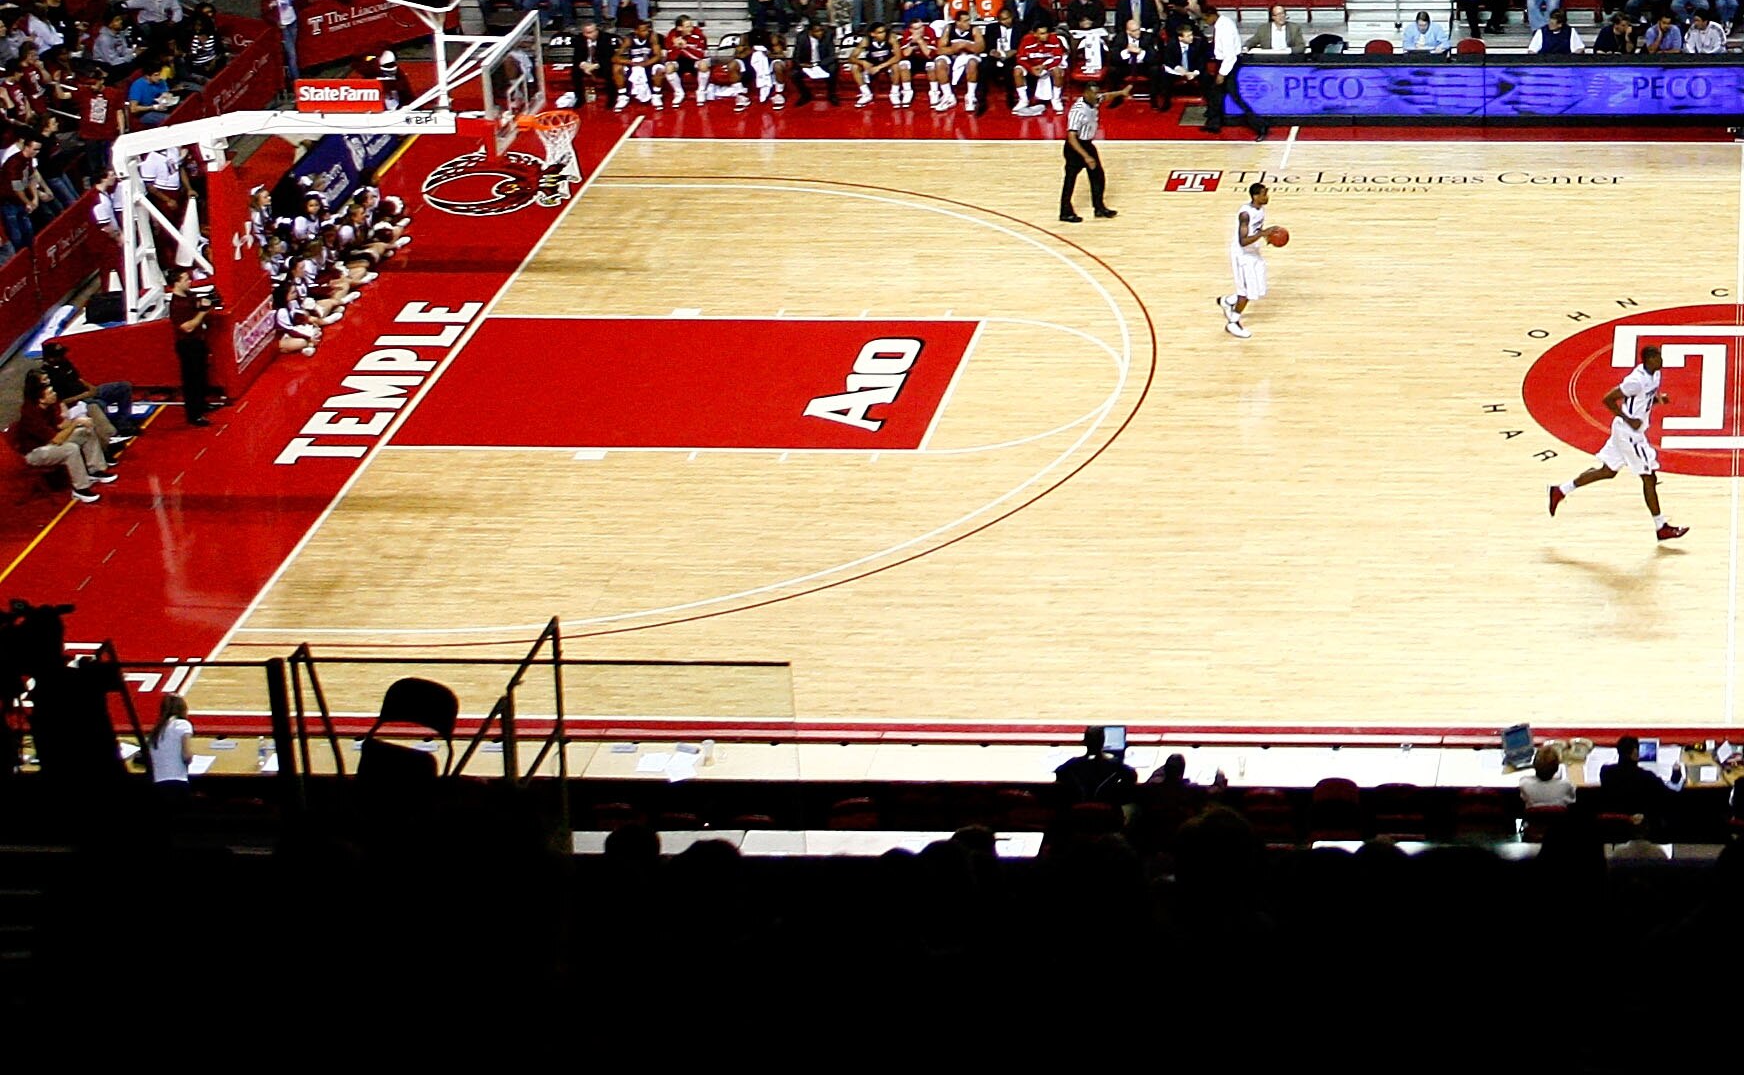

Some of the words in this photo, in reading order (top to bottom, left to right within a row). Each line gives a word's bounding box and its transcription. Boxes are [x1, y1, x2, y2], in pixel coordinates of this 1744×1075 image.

[324, 10, 349, 25] The
[1283, 75, 1364, 100] PECO
[1632, 75, 1713, 100] PECO
[1229, 170, 1301, 185] The
[1313, 170, 1486, 185] Liacouras
[1497, 170, 1625, 185] Center
[1503, 297, 1640, 359] JOHN
[274, 300, 484, 466] TEMPLE
[803, 337, 925, 432] A10
